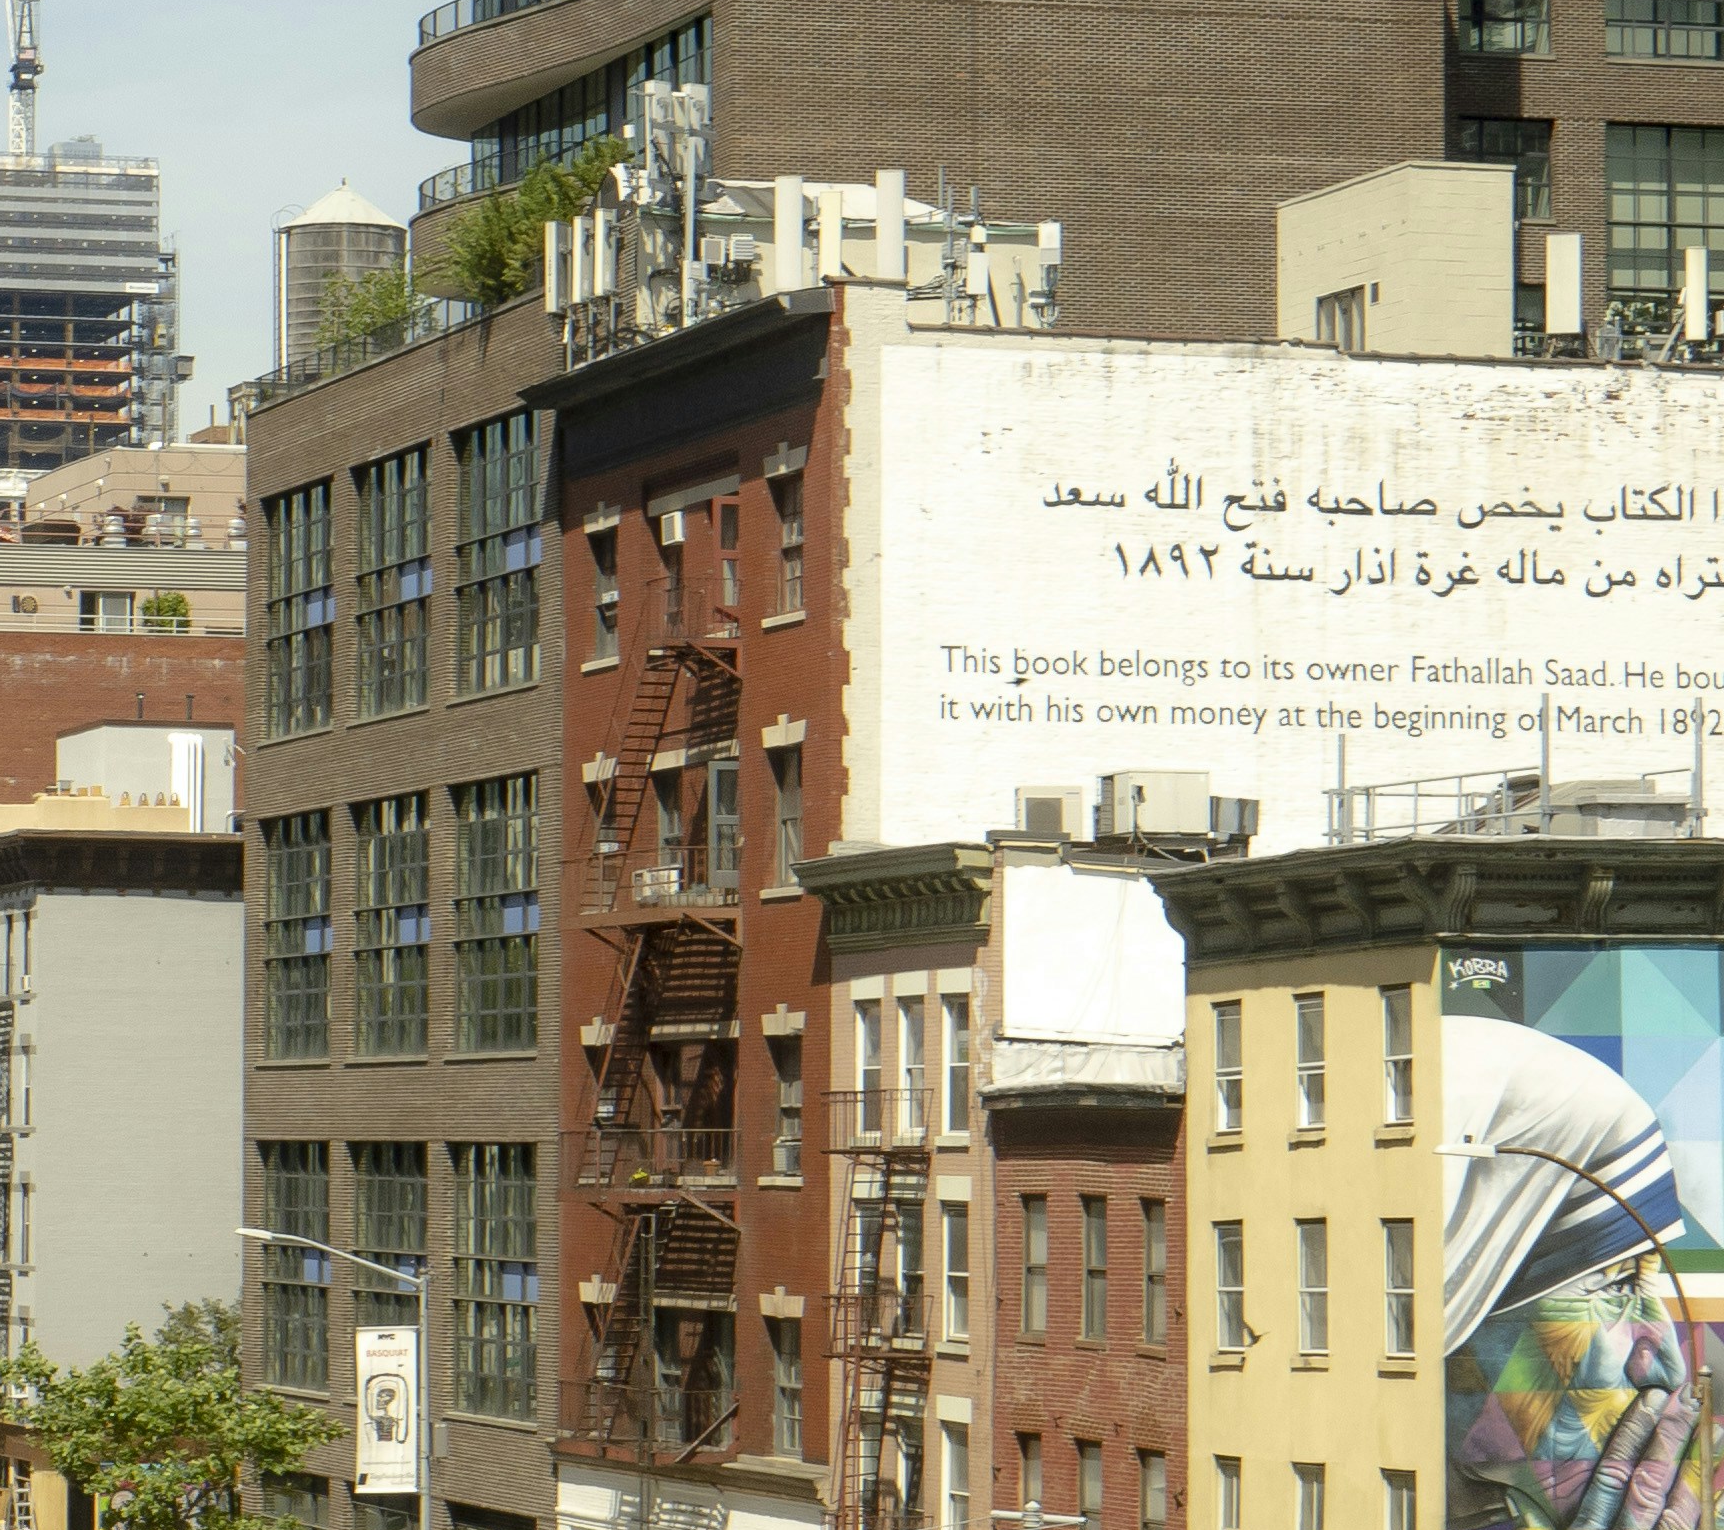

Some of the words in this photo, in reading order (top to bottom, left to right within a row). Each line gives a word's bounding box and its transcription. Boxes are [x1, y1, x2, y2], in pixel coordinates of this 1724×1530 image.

[1043, 482, 1126, 508] سعد
[1144, 457, 1203, 510] الله
[1223, 477, 1286, 531] فتح
[1307, 479, 1437, 526] صاحبه
[1458, 485, 1564, 532] يخص
[1584, 484, 1695, 535] الكتاب
[1114, 542, 1219, 579] ١٨٩٢
[1241, 541, 1314, 581] سنة
[1329, 547, 1396, 595] اذار
[1415, 551, 1480, 598] غرة
[1497, 548, 1566, 586] ماله
[1586, 559, 1637, 597] من
[940, 645, 1001, 674] This
[1013, 648, 1089, 676] book
[1100, 649, 1209, 686] belongs
[1221, 657, 1251, 679] to
[1263, 654, 1295, 680] its
[1306, 662, 1400, 682] owner
[1412, 655, 1533, 685] Fathallah
[1545, 658, 1615, 687] Saad.
[1624, 661, 1664, 688] He
[940, 694, 959, 720] it
[970, 694, 1033, 722] with
[1047, 695, 1084, 723] his
[1096, 704, 1158, 724] own
[1171, 706, 1268, 735] money
[1279, 706, 1306, 727] at
[1318, 701, 1362, 727] the
[1374, 702, 1507, 740] beginning
[1557, 705, 1643, 734] March
[1447, 958, 1508, 979] KOBRA
[366, 1348, 409, 1358] BASQUIAT
